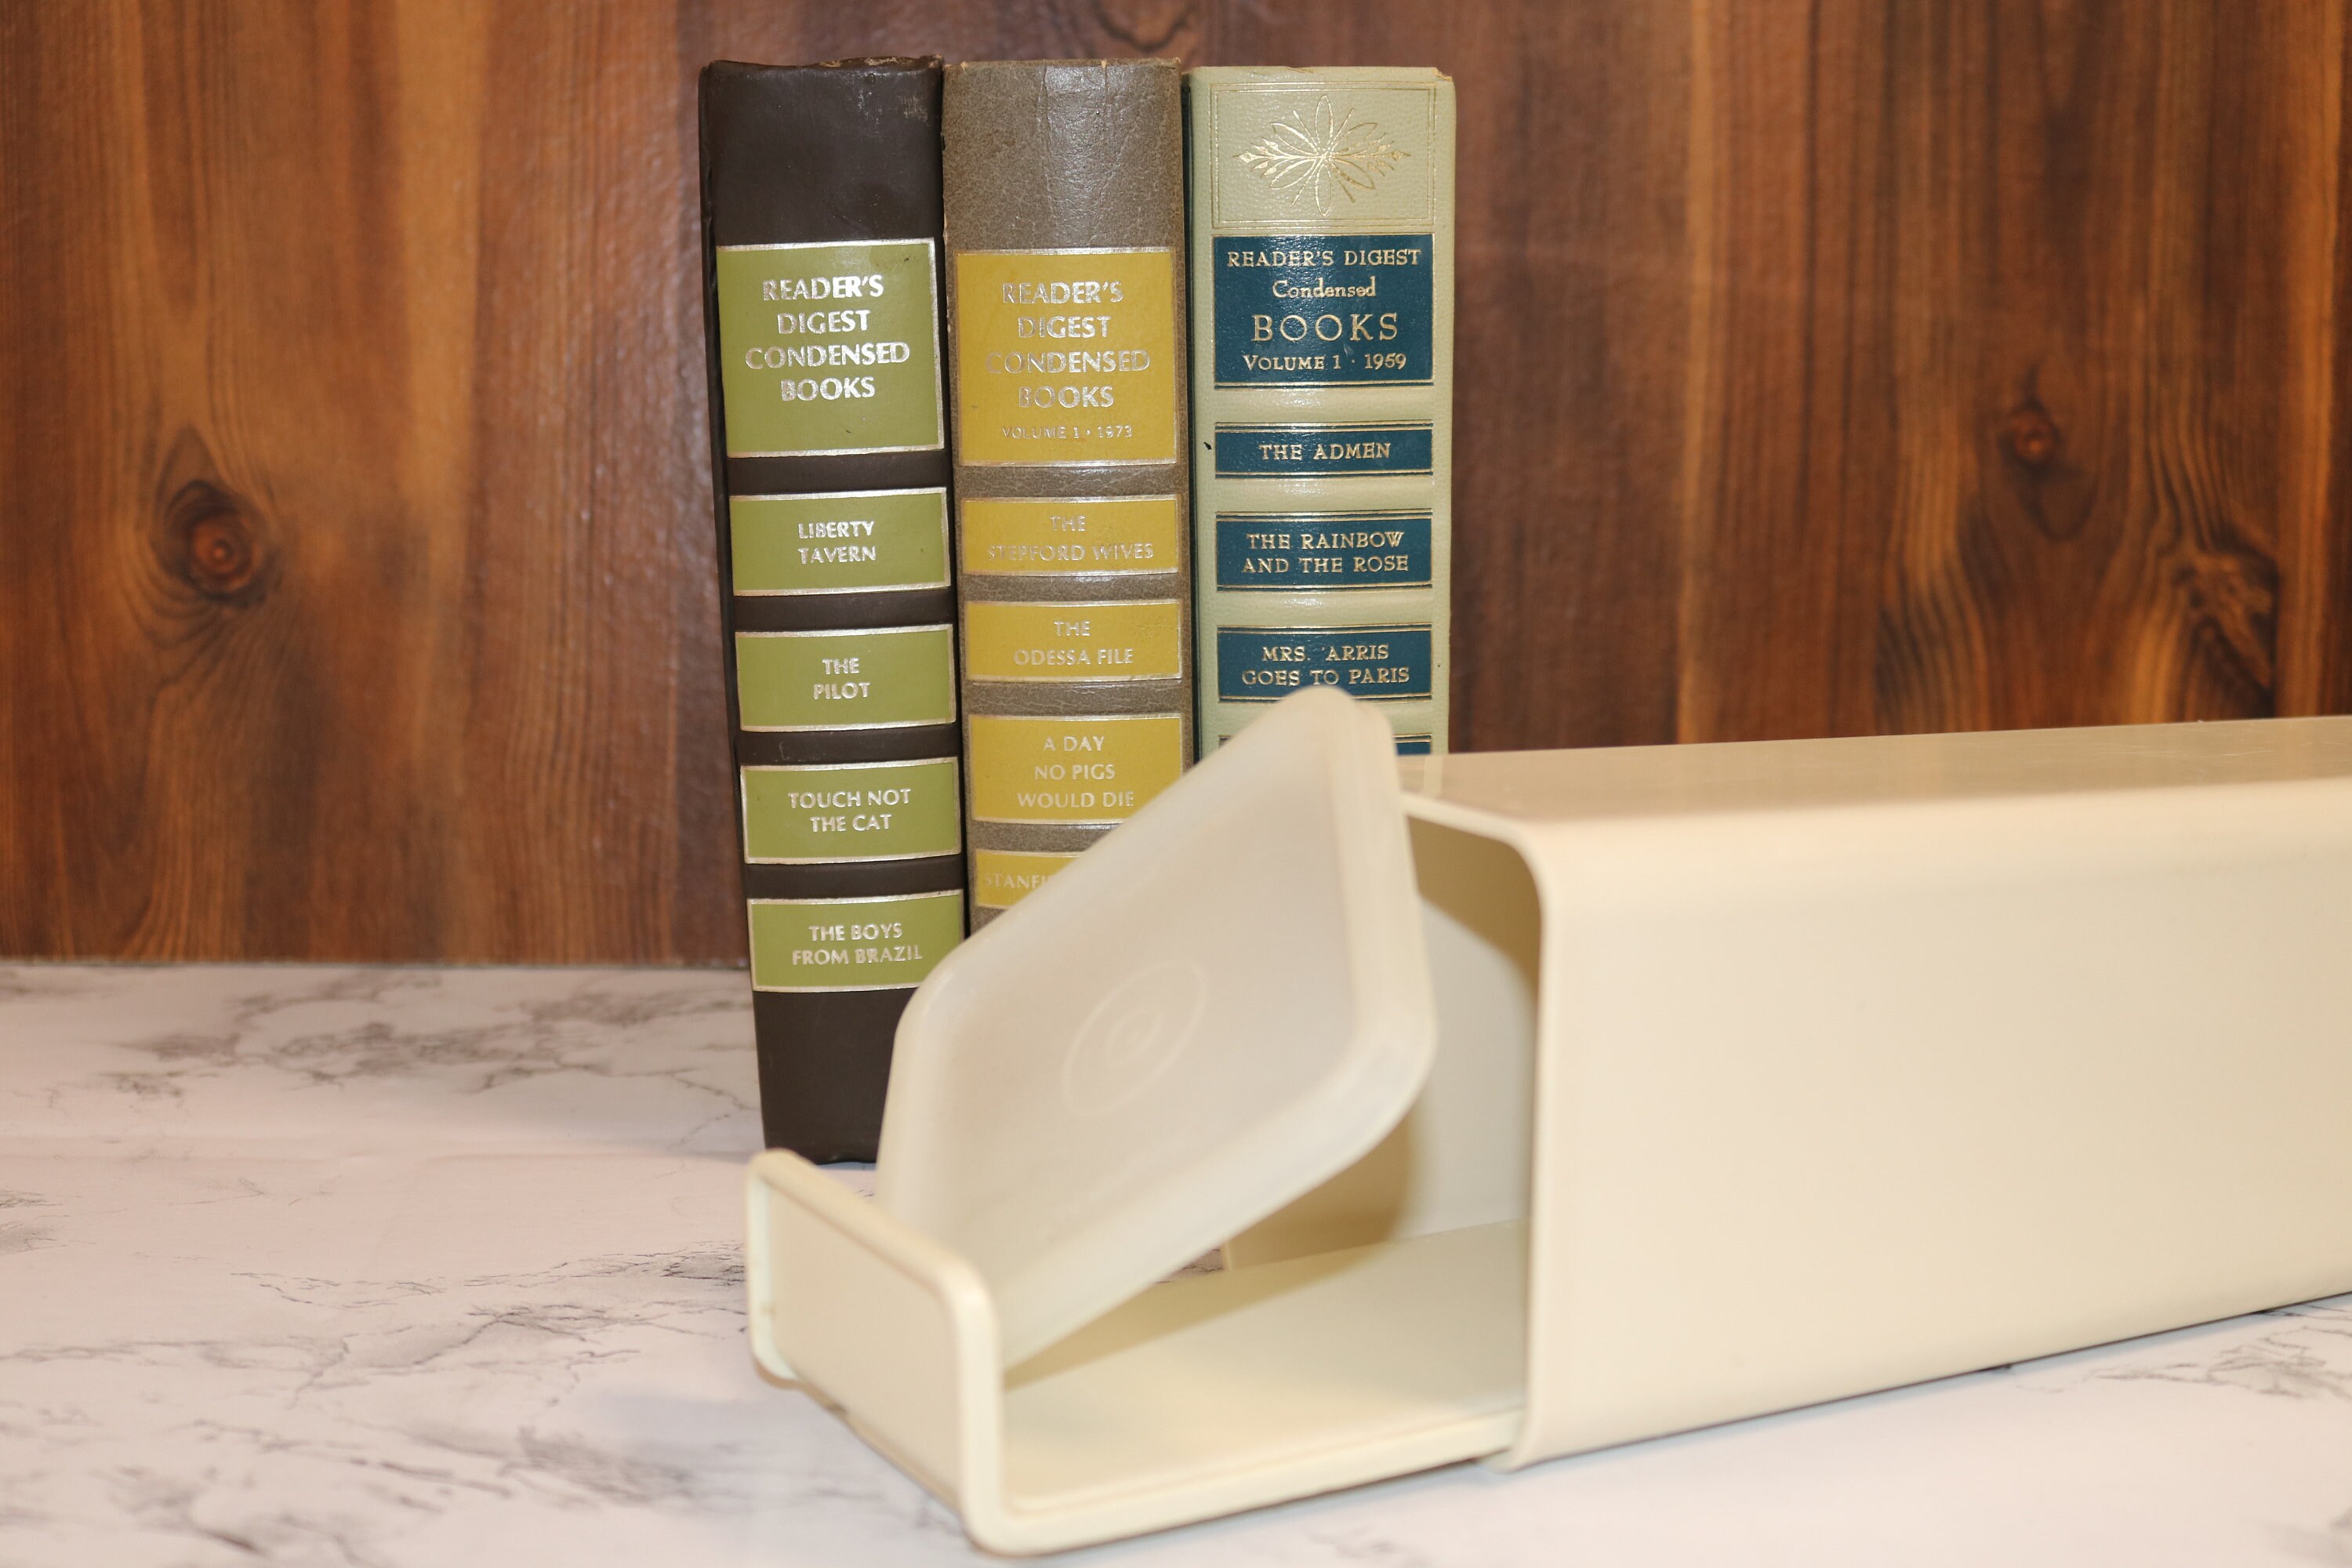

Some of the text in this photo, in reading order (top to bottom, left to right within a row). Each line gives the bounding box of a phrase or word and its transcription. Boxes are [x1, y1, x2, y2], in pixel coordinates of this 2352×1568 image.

[1227, 249, 1421, 267] READER'S DIGEST
[763, 274, 884, 300] READER'S
[1003, 281, 1123, 304] READER'S
[1272, 276, 1377, 299] Condensed
[777, 310, 870, 334] DIGEST
[1018, 316, 1111, 339] DIGEST
[1251, 313, 1398, 342] BOOKS
[746, 341, 910, 369] CONDENSED
[985, 350, 1150, 374] CONDENSED
[1243, 354, 1406, 371] VOLUME 1 1959
[781, 376, 876, 401] BOOKS
[1018, 386, 1114, 408] BOOKS
[1002, 426, 1133, 439] VOLUME 1 1973
[1258, 442, 1391, 461] THE ADMEN
[797, 521, 875, 539] LIBERTY
[1049, 515, 1086, 532] THE
[1247, 531, 1405, 550] THE RAINBOW
[797, 546, 877, 564] TAVERN
[988, 543, 1154, 561] STEPFORD WIVES
[1242, 555, 1409, 573] AND THE ROSE
[1054, 620, 1091, 637] THE
[1013, 648, 1134, 666] ODESSA FILE
[1261, 645, 1311, 662] MRS.
[822, 658, 860, 674] THE
[1242, 666, 1410, 686] GOES TO PARIS
[813, 682, 871, 699] PILOT
[1044, 735, 1105, 752] A DAY
[1035, 764, 1116, 780] NO PIGS
[787, 788, 911, 809] TOUCH NOT
[1017, 791, 1134, 808] WOULD DIE
[810, 814, 891, 833] THE CAT
[985, 873, 1054, 889] STANFI
[808, 922, 903, 942] THE BOYS
[792, 944, 923, 966] FROM BRAZIL
